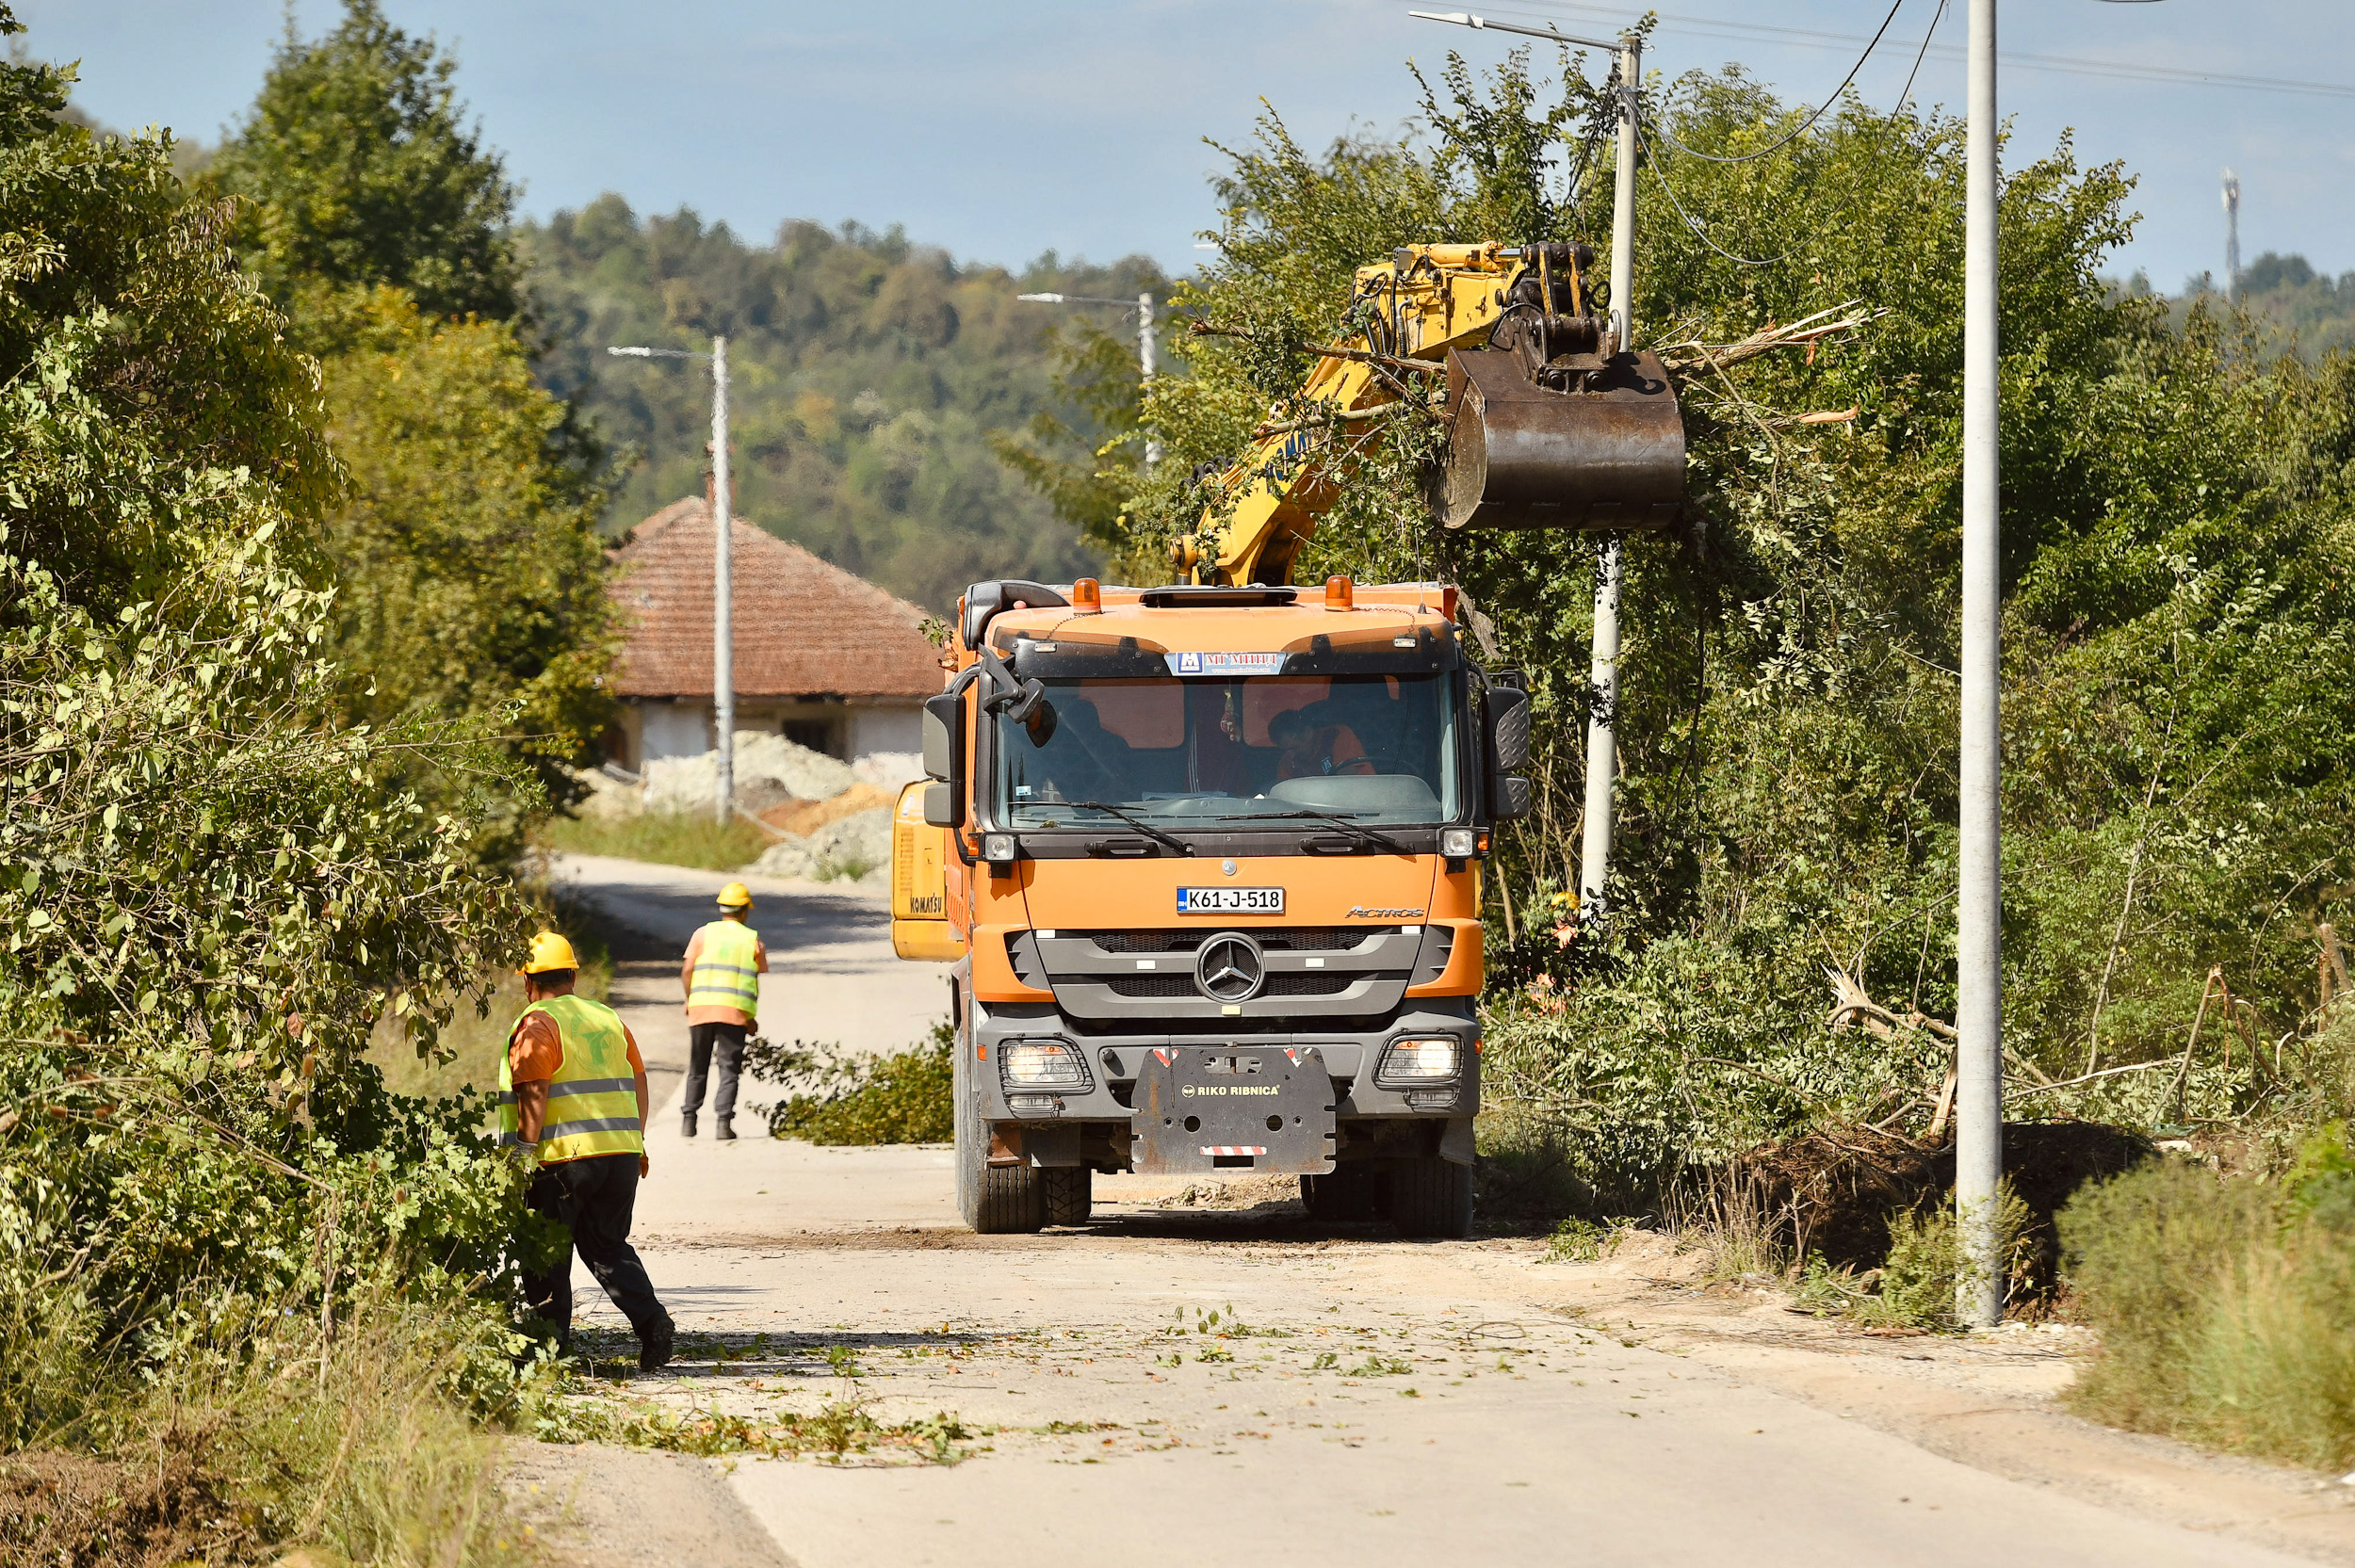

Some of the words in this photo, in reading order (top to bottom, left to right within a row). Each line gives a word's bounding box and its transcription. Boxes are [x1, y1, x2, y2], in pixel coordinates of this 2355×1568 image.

[910, 894, 942, 913] KOMATSU
[1190, 892, 1279, 907] K61-J-518
[1197, 1086, 1227, 1095] RIKO
[1230, 1086, 1278, 1095] RIBNICA
